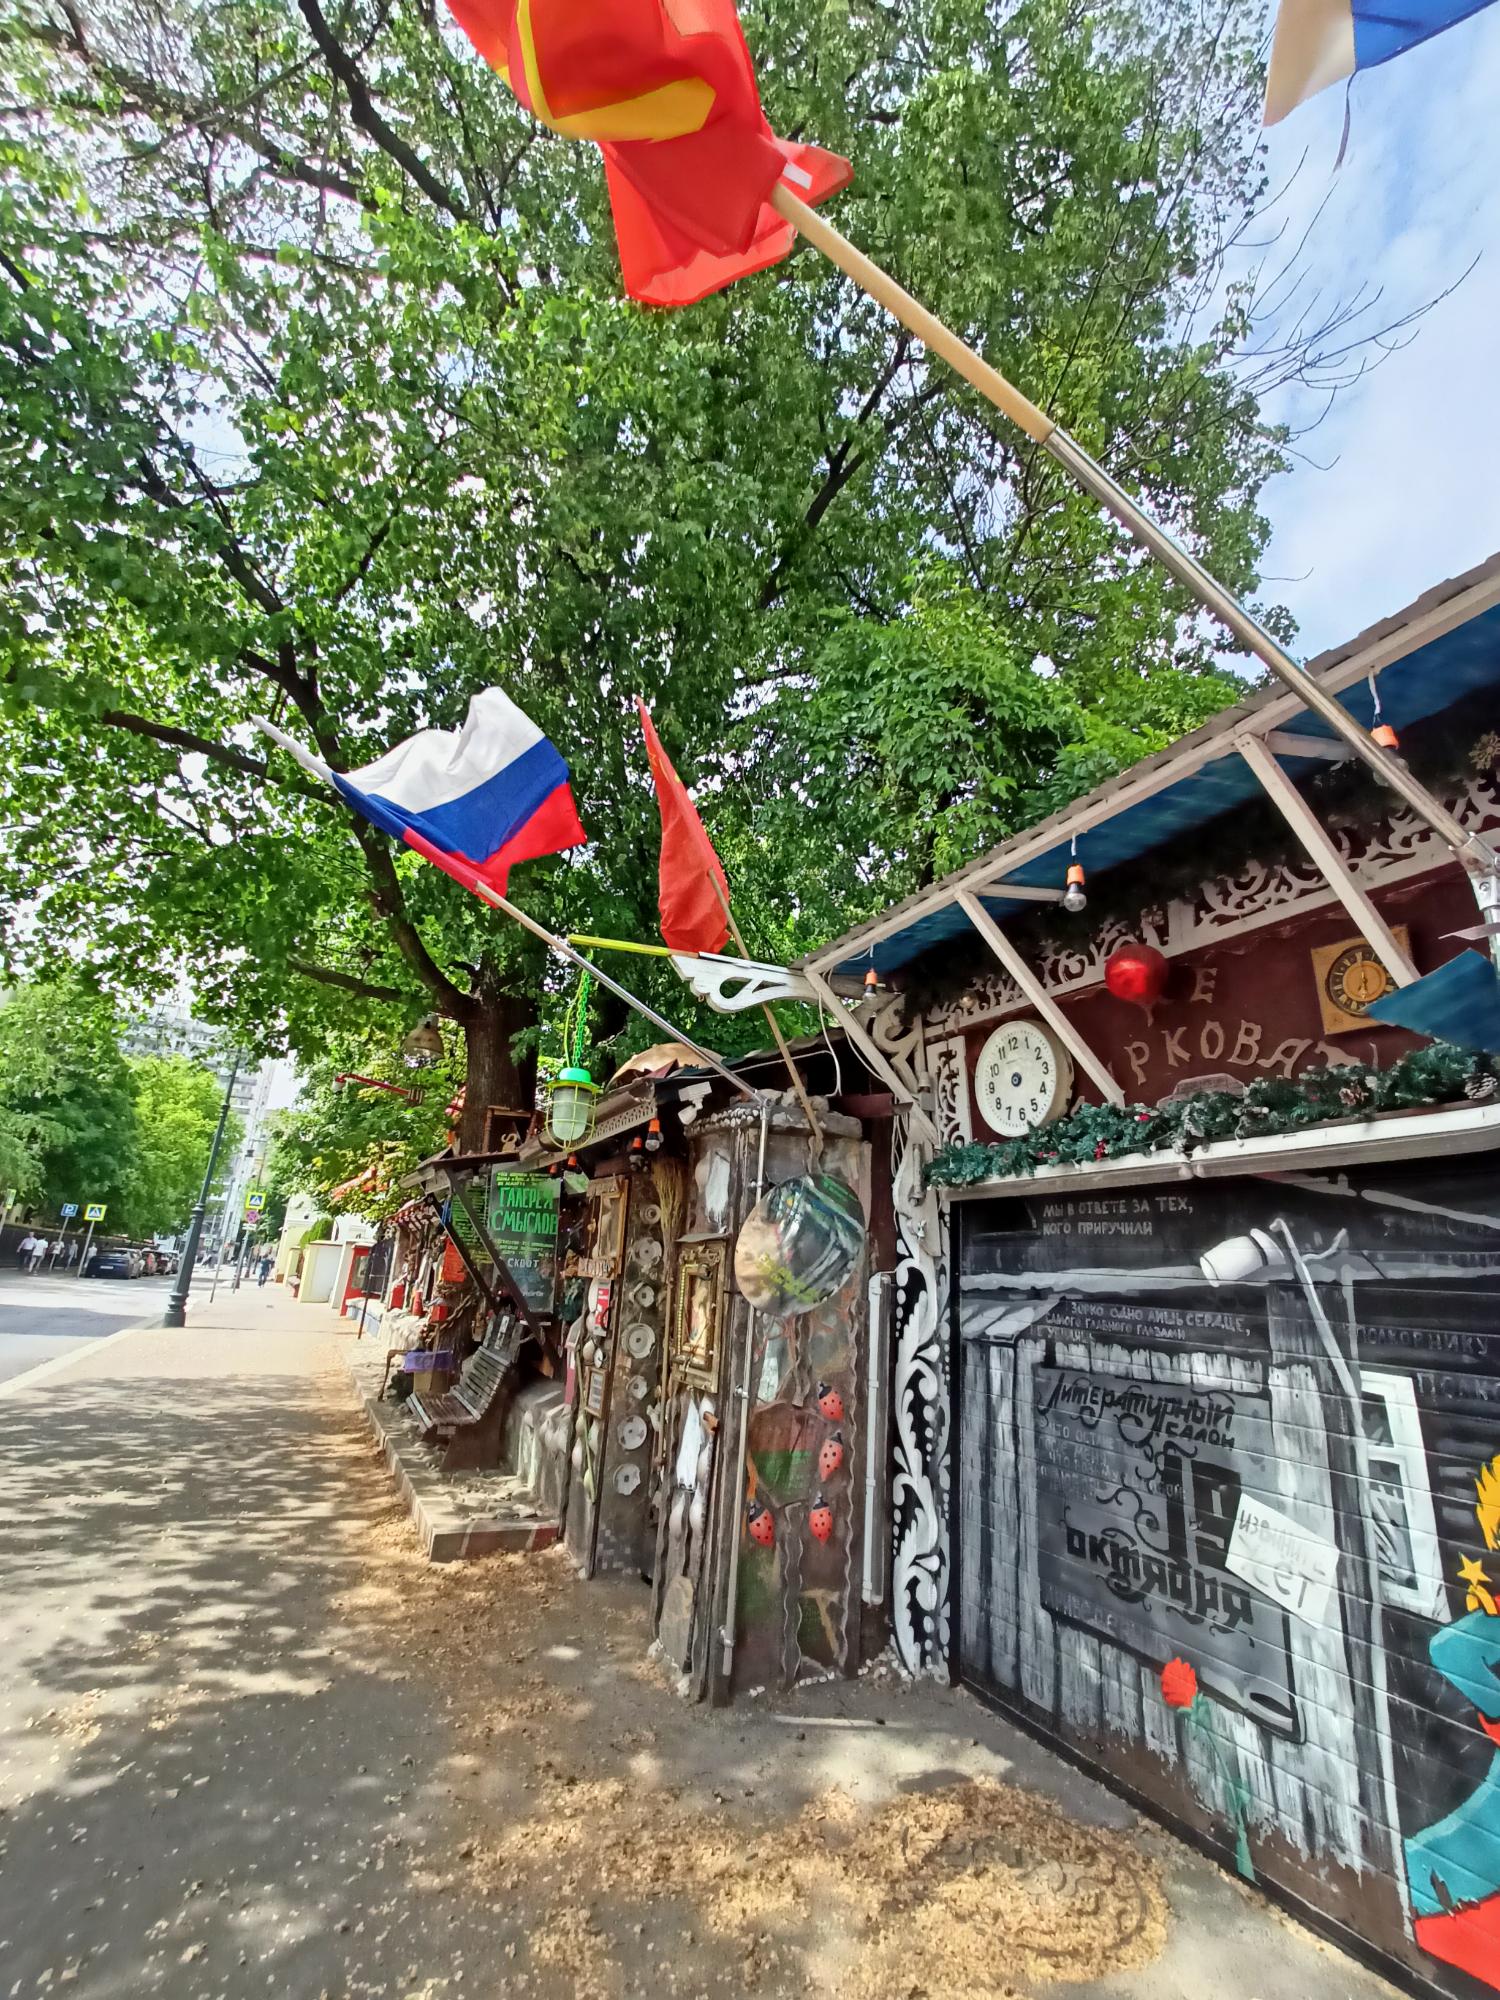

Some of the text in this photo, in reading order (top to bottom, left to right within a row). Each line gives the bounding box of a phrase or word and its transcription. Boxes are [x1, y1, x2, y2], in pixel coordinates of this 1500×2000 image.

[1008, 1037, 1018, 1051] 12
[1025, 1037, 1029, 1049] 1
[998, 1046, 1006, 1060] 11
[1035, 1047, 1042, 1060] 2
[990, 1063, 999, 1077] 10
[1042, 1061, 1049, 1075] 3
[989, 1081, 995, 1094] 9
[1040, 1081, 1047, 1095] 4
[995, 1097, 1002, 1110] 8
[1031, 1098, 1038, 1112] 5
[1006, 1106, 1012, 1120] 7
[1019, 1108, 1026, 1121] 6
[499, 1187, 554, 1209] ГАЛЕРЕЯ
[1043, 1197, 1193, 1217] МЫ В ОТВЕТЕ ЗА ТЕХ,
[491, 1210, 558, 1235] СМЫСЛОВ
[1043, 1222, 1071, 1236] КОГО
[1071, 1301, 1103, 1317] ЗОРКО
[1110, 1304, 1144, 1321] ОДНО
[1148, 1309, 1183, 1326] ЛИШЬ
